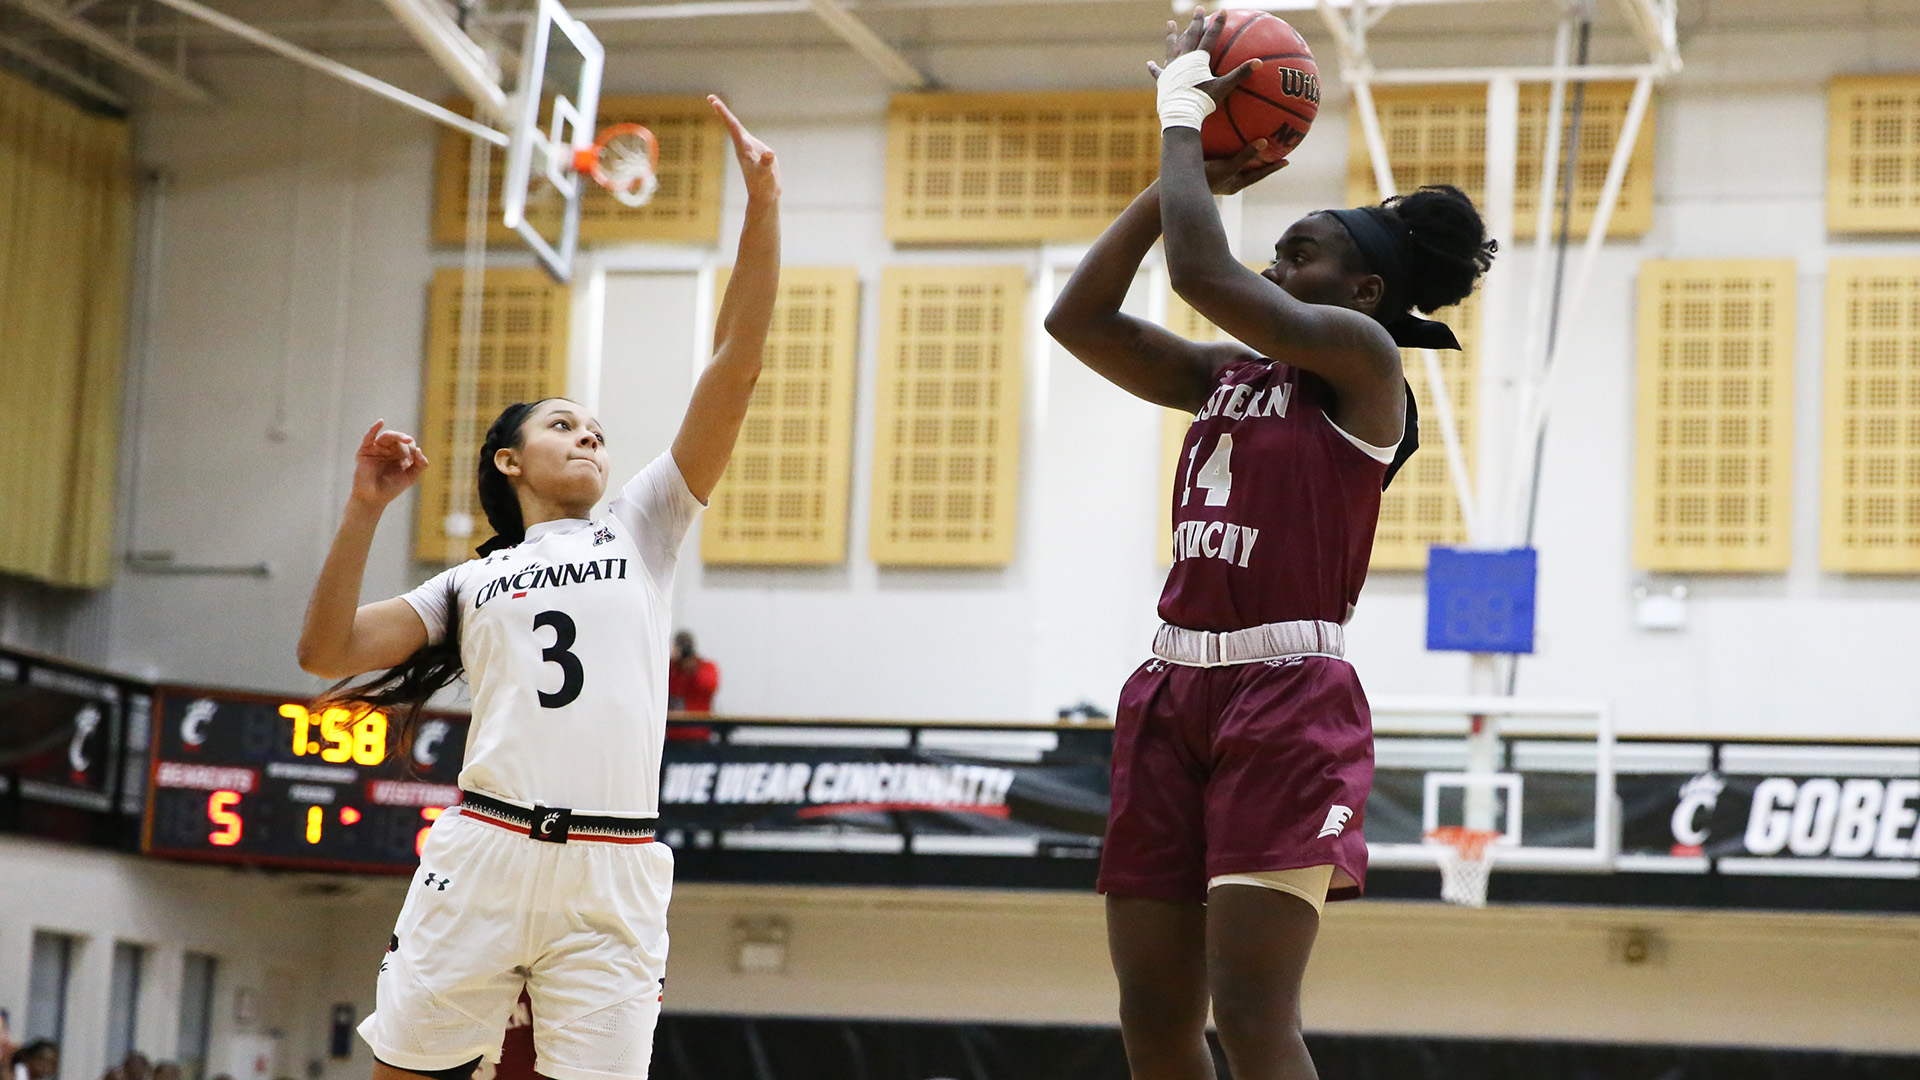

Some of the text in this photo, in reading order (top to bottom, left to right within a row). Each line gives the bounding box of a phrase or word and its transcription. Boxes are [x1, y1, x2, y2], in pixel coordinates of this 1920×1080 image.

[1181, 433, 1234, 507] 14
[475, 558, 627, 610] CINCINNATI
[532, 610, 585, 709] 3
[278, 703, 388, 766] 7:58
[663, 763, 718, 803] WE
[713, 763, 812, 804] WEAR
[207, 790, 243, 846] 5
[306, 805, 323, 844] 1
[1743, 777, 1920, 858] GOBE
